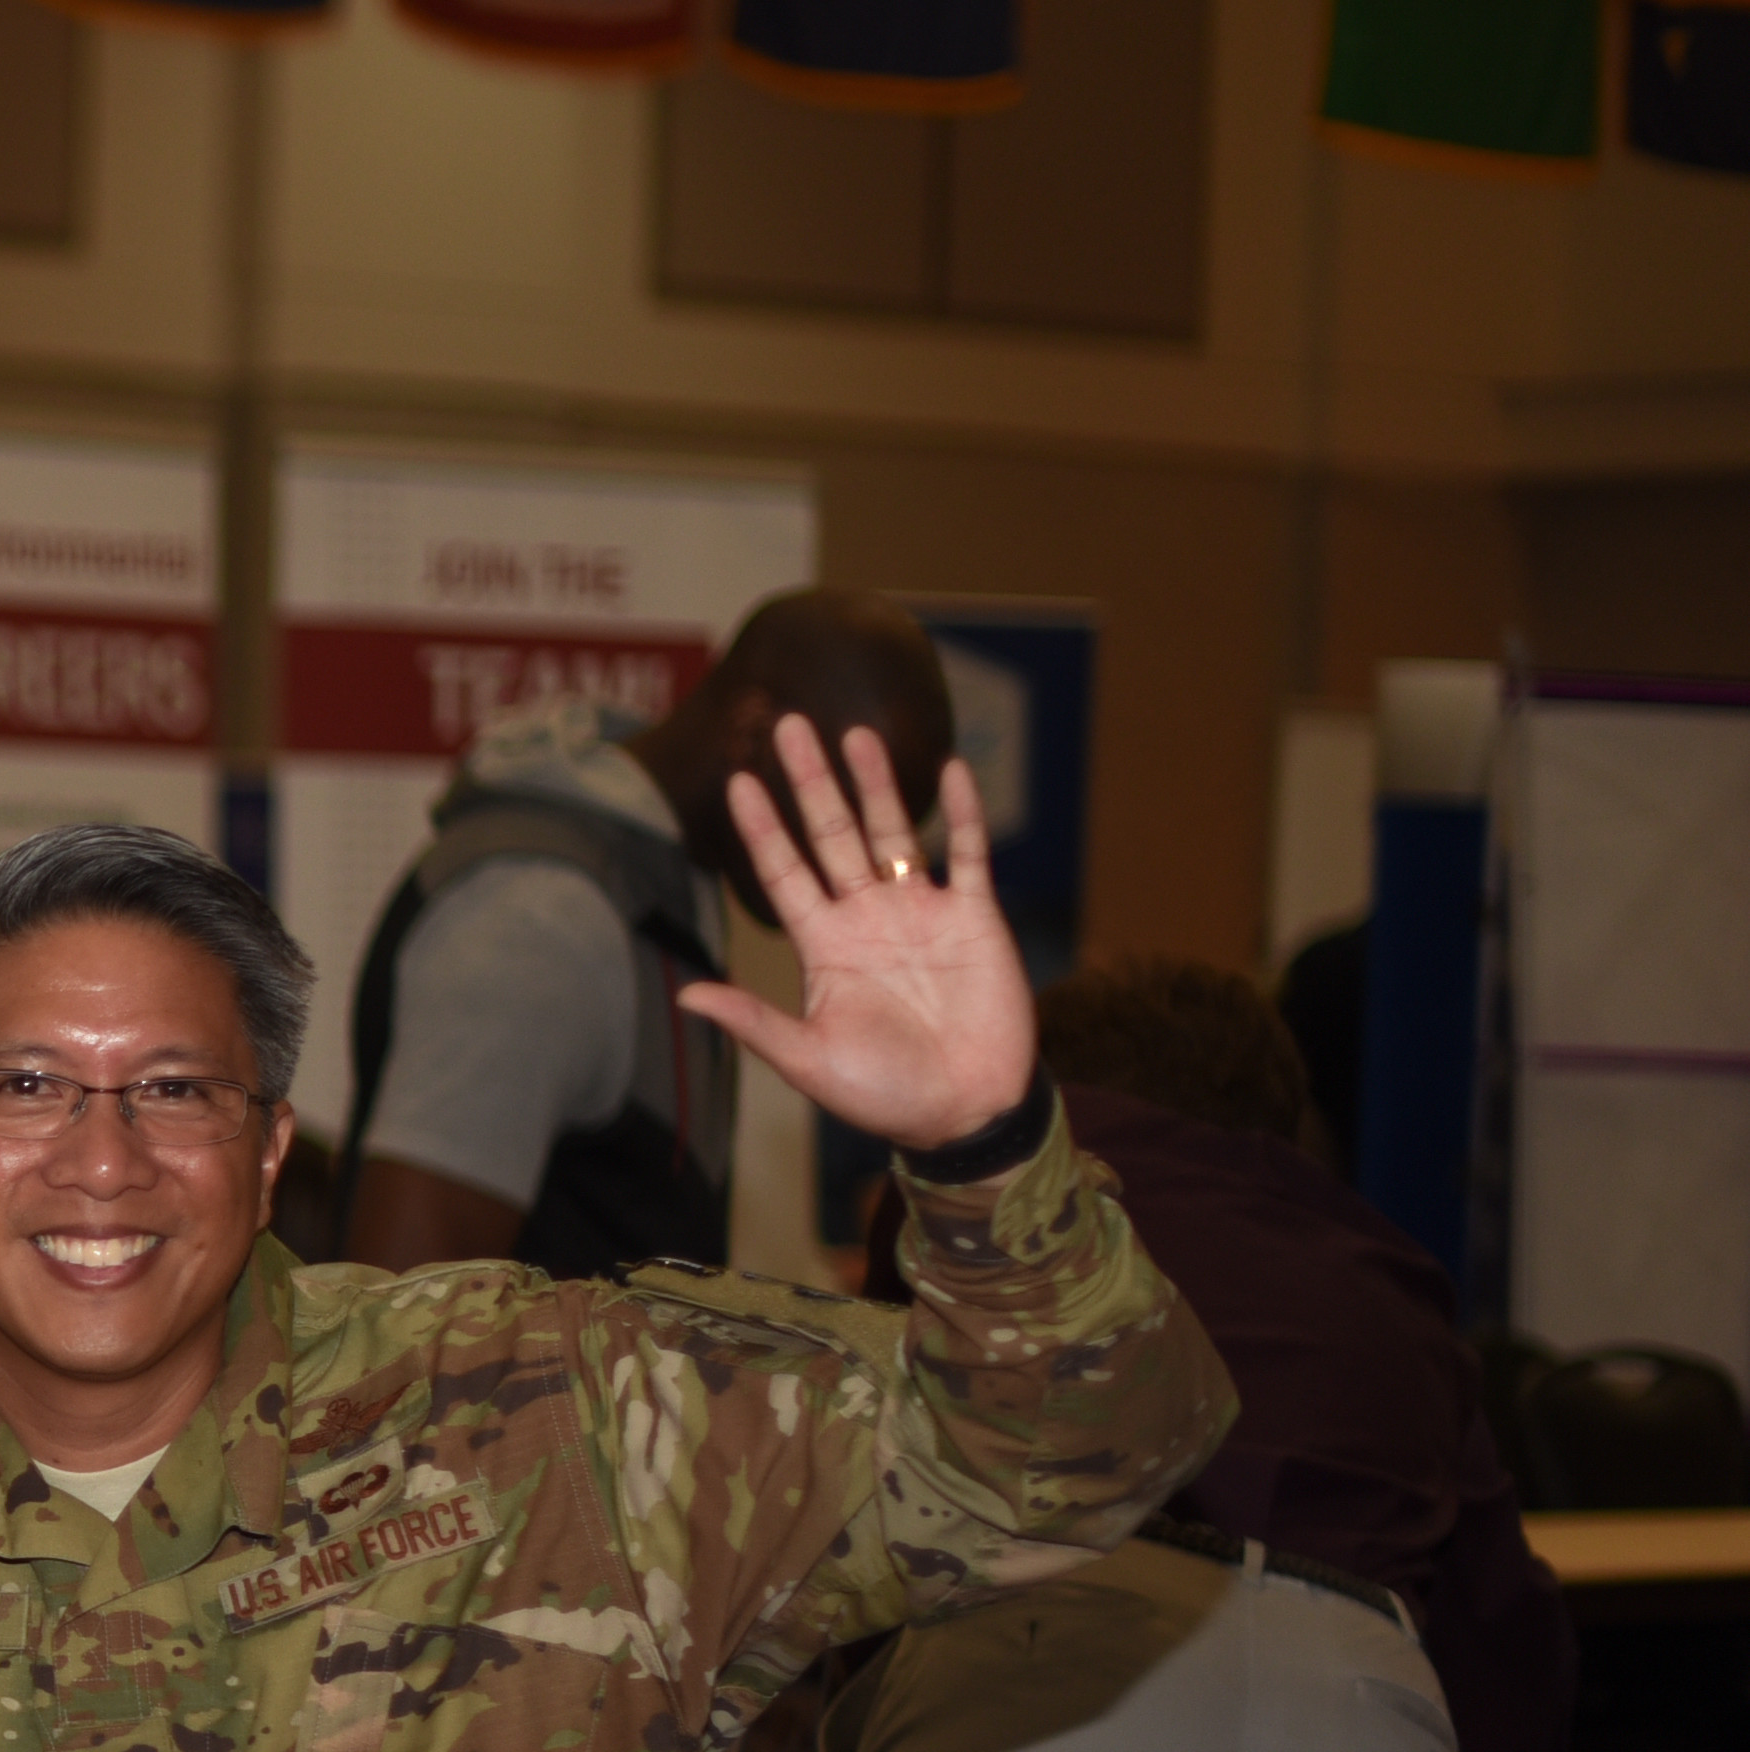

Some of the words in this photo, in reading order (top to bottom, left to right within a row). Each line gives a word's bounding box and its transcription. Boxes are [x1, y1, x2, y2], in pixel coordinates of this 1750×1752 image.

[422, 536, 524, 595] JOIN
[532, 542, 635, 600] THE
[301, 1541, 358, 1595] AIR
[357, 1494, 480, 1570] FORCE
